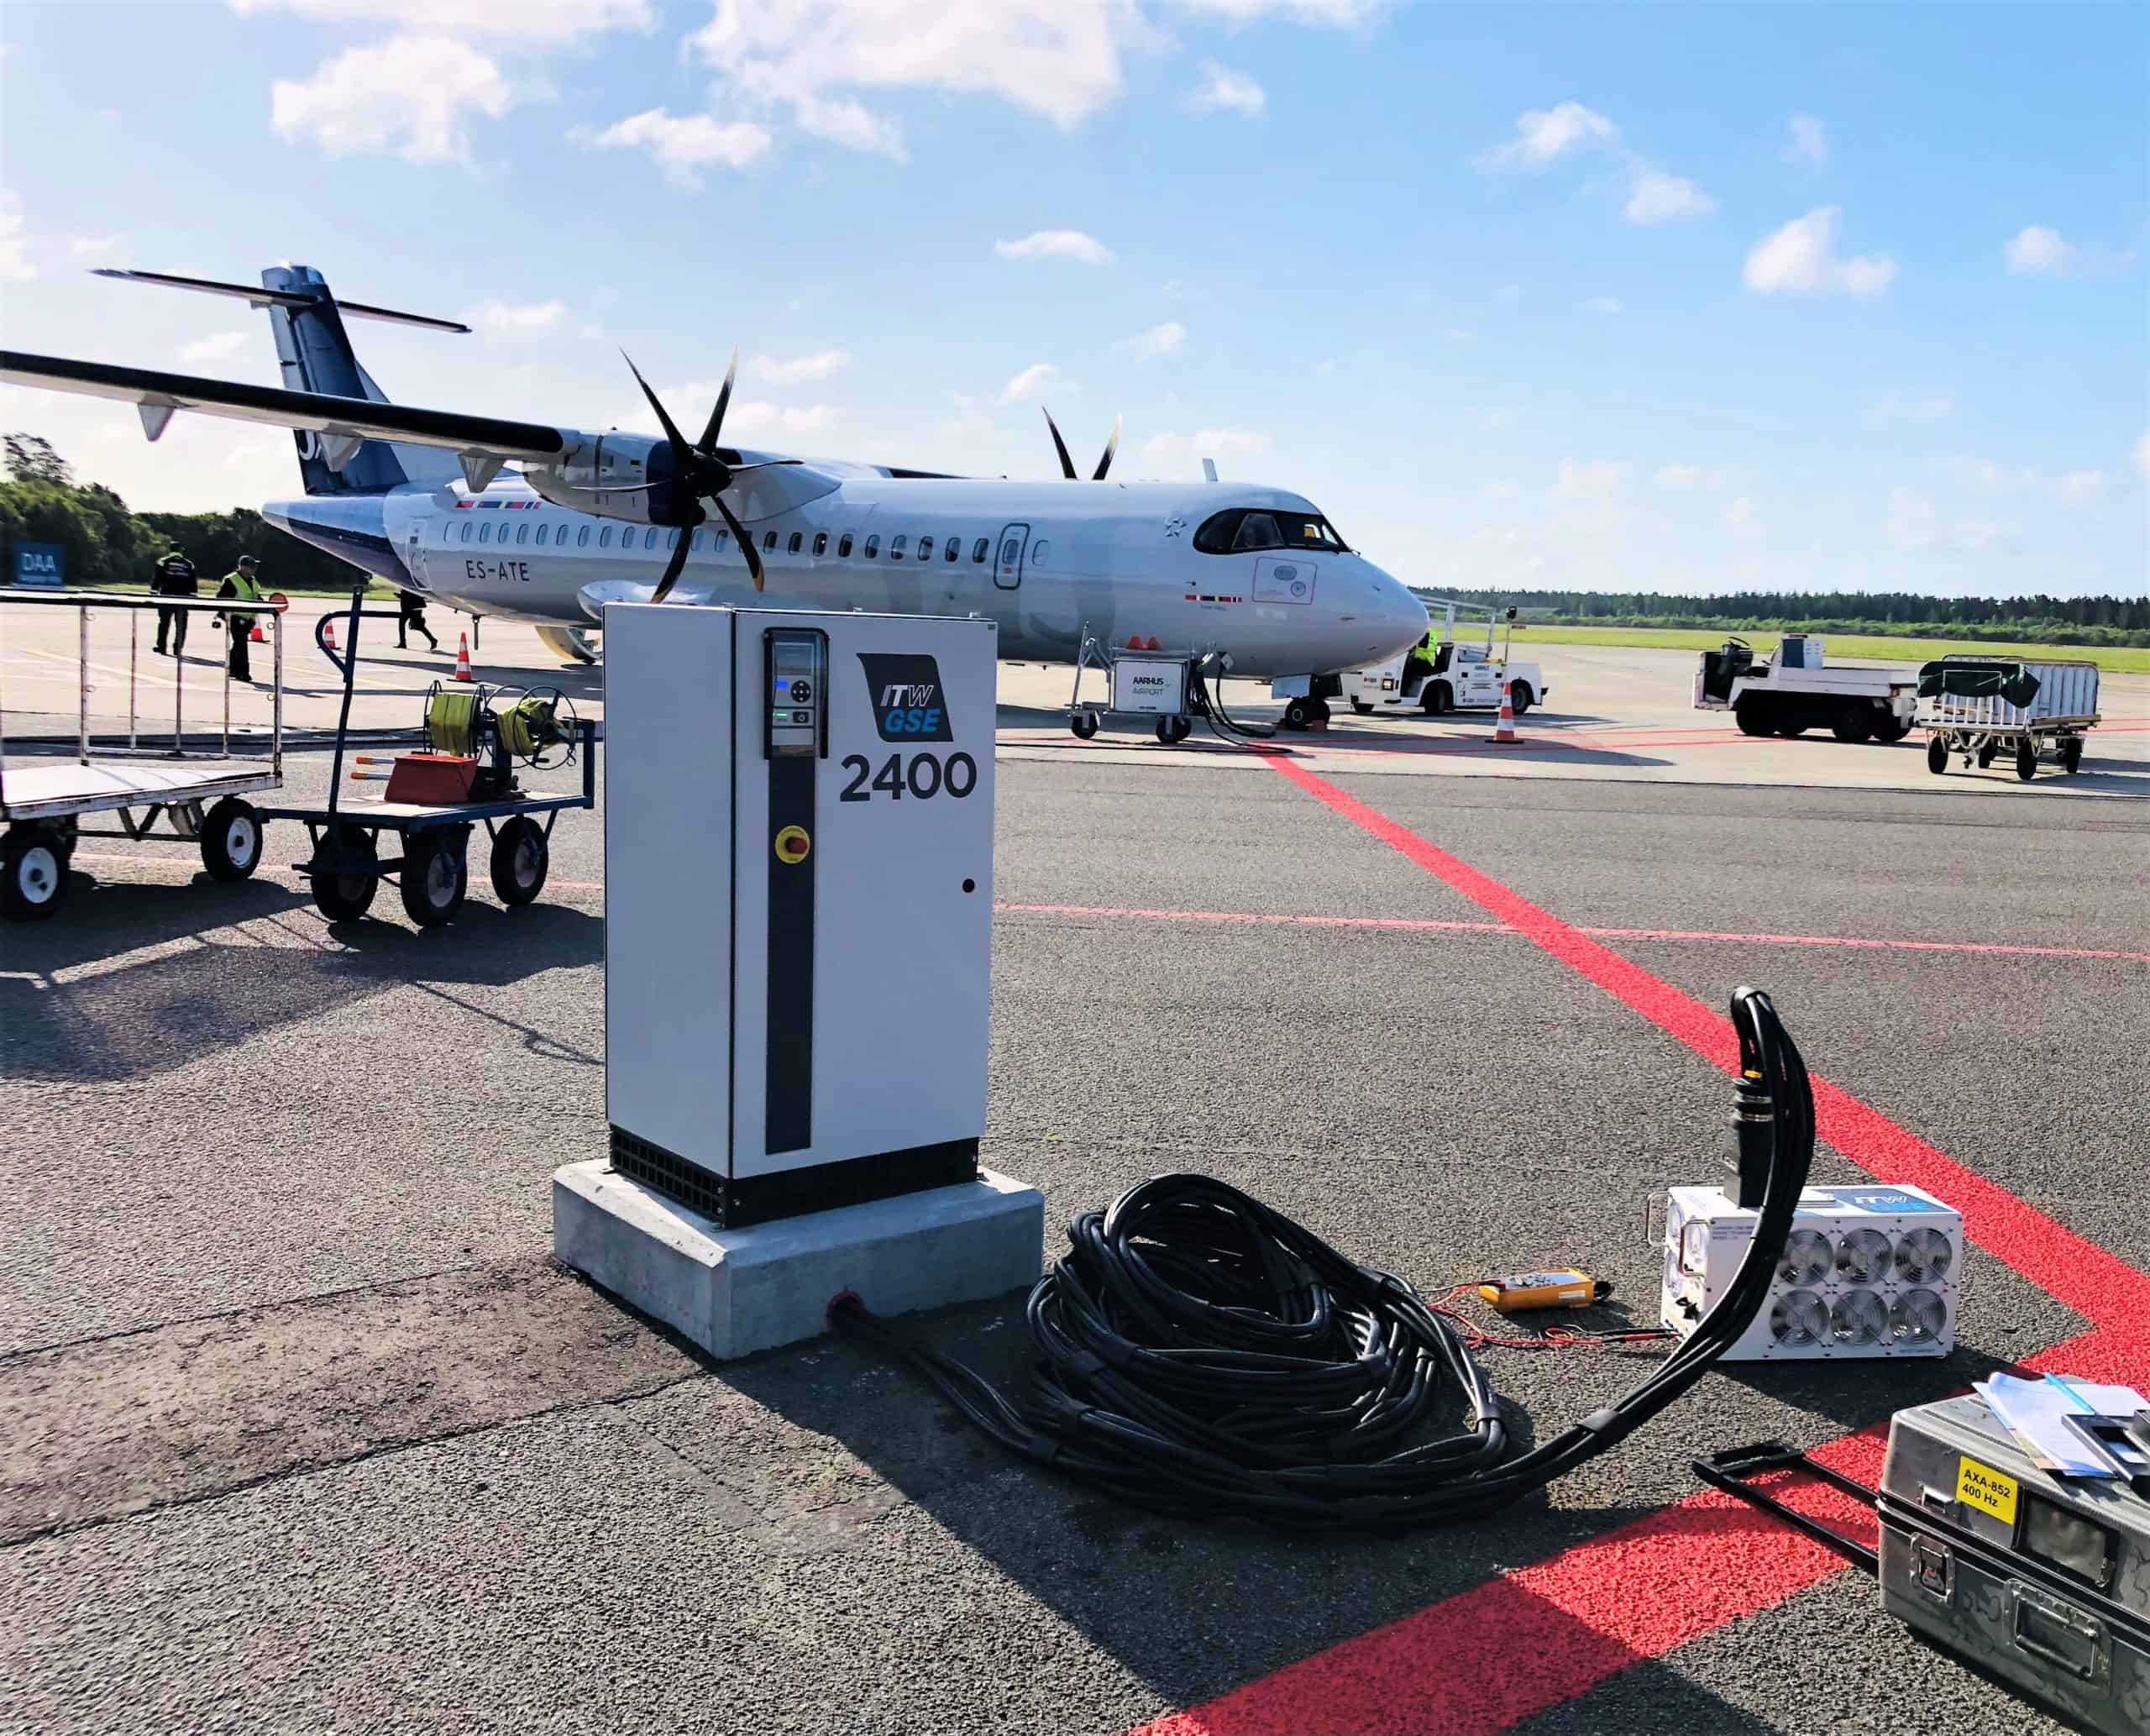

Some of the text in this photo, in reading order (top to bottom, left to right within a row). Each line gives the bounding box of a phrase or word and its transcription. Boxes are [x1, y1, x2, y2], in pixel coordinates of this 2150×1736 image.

[465, 559, 530, 581] ES-ATE
[1132, 676, 1164, 685] AARHUS
[879, 684, 934, 707] ITW
[884, 708, 941, 733] GSE
[840, 752, 977, 802] 2400
[1962, 1483, 1998, 1508] 400 Hz
[1964, 1469, 2011, 1498] AXA-852
